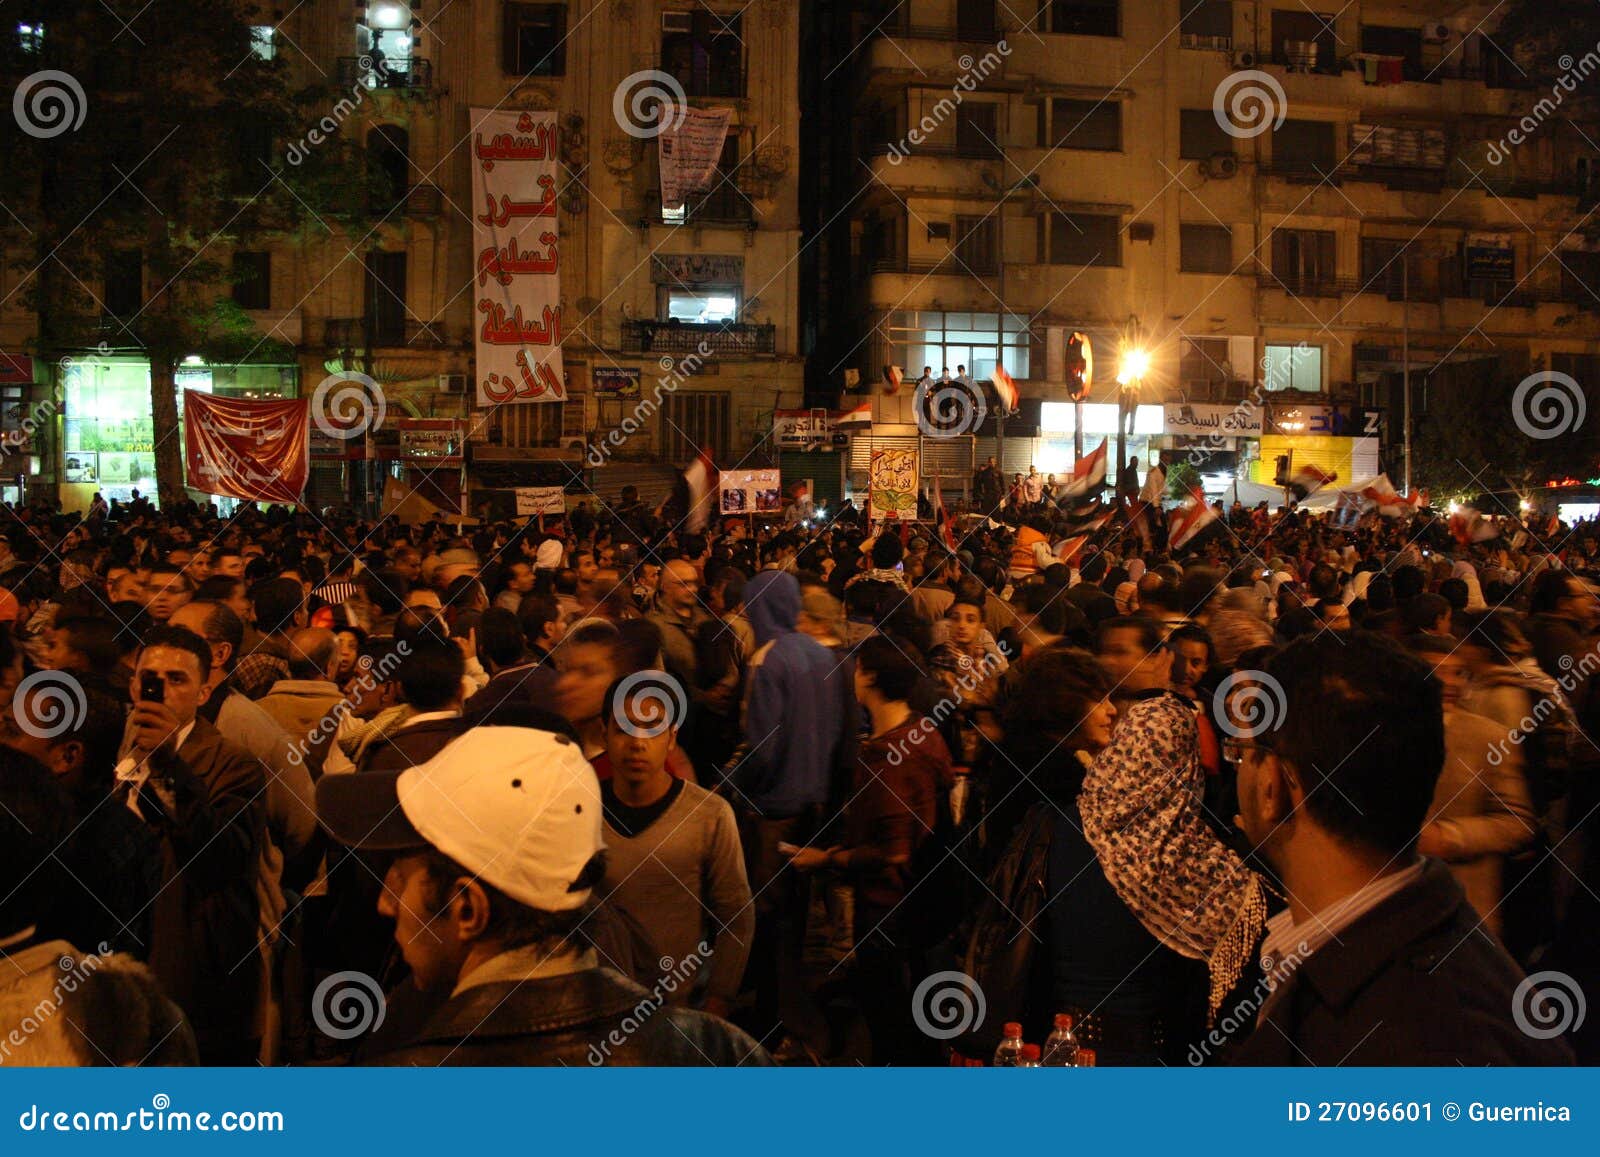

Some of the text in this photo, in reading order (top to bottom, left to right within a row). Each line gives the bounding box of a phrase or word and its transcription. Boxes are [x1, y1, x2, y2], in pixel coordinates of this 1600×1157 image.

[475, 112, 557, 172] الشعب
[478, 174, 558, 228] قرر
[478, 231, 559, 287] تسليم
[478, 298, 562, 347] السلطة
